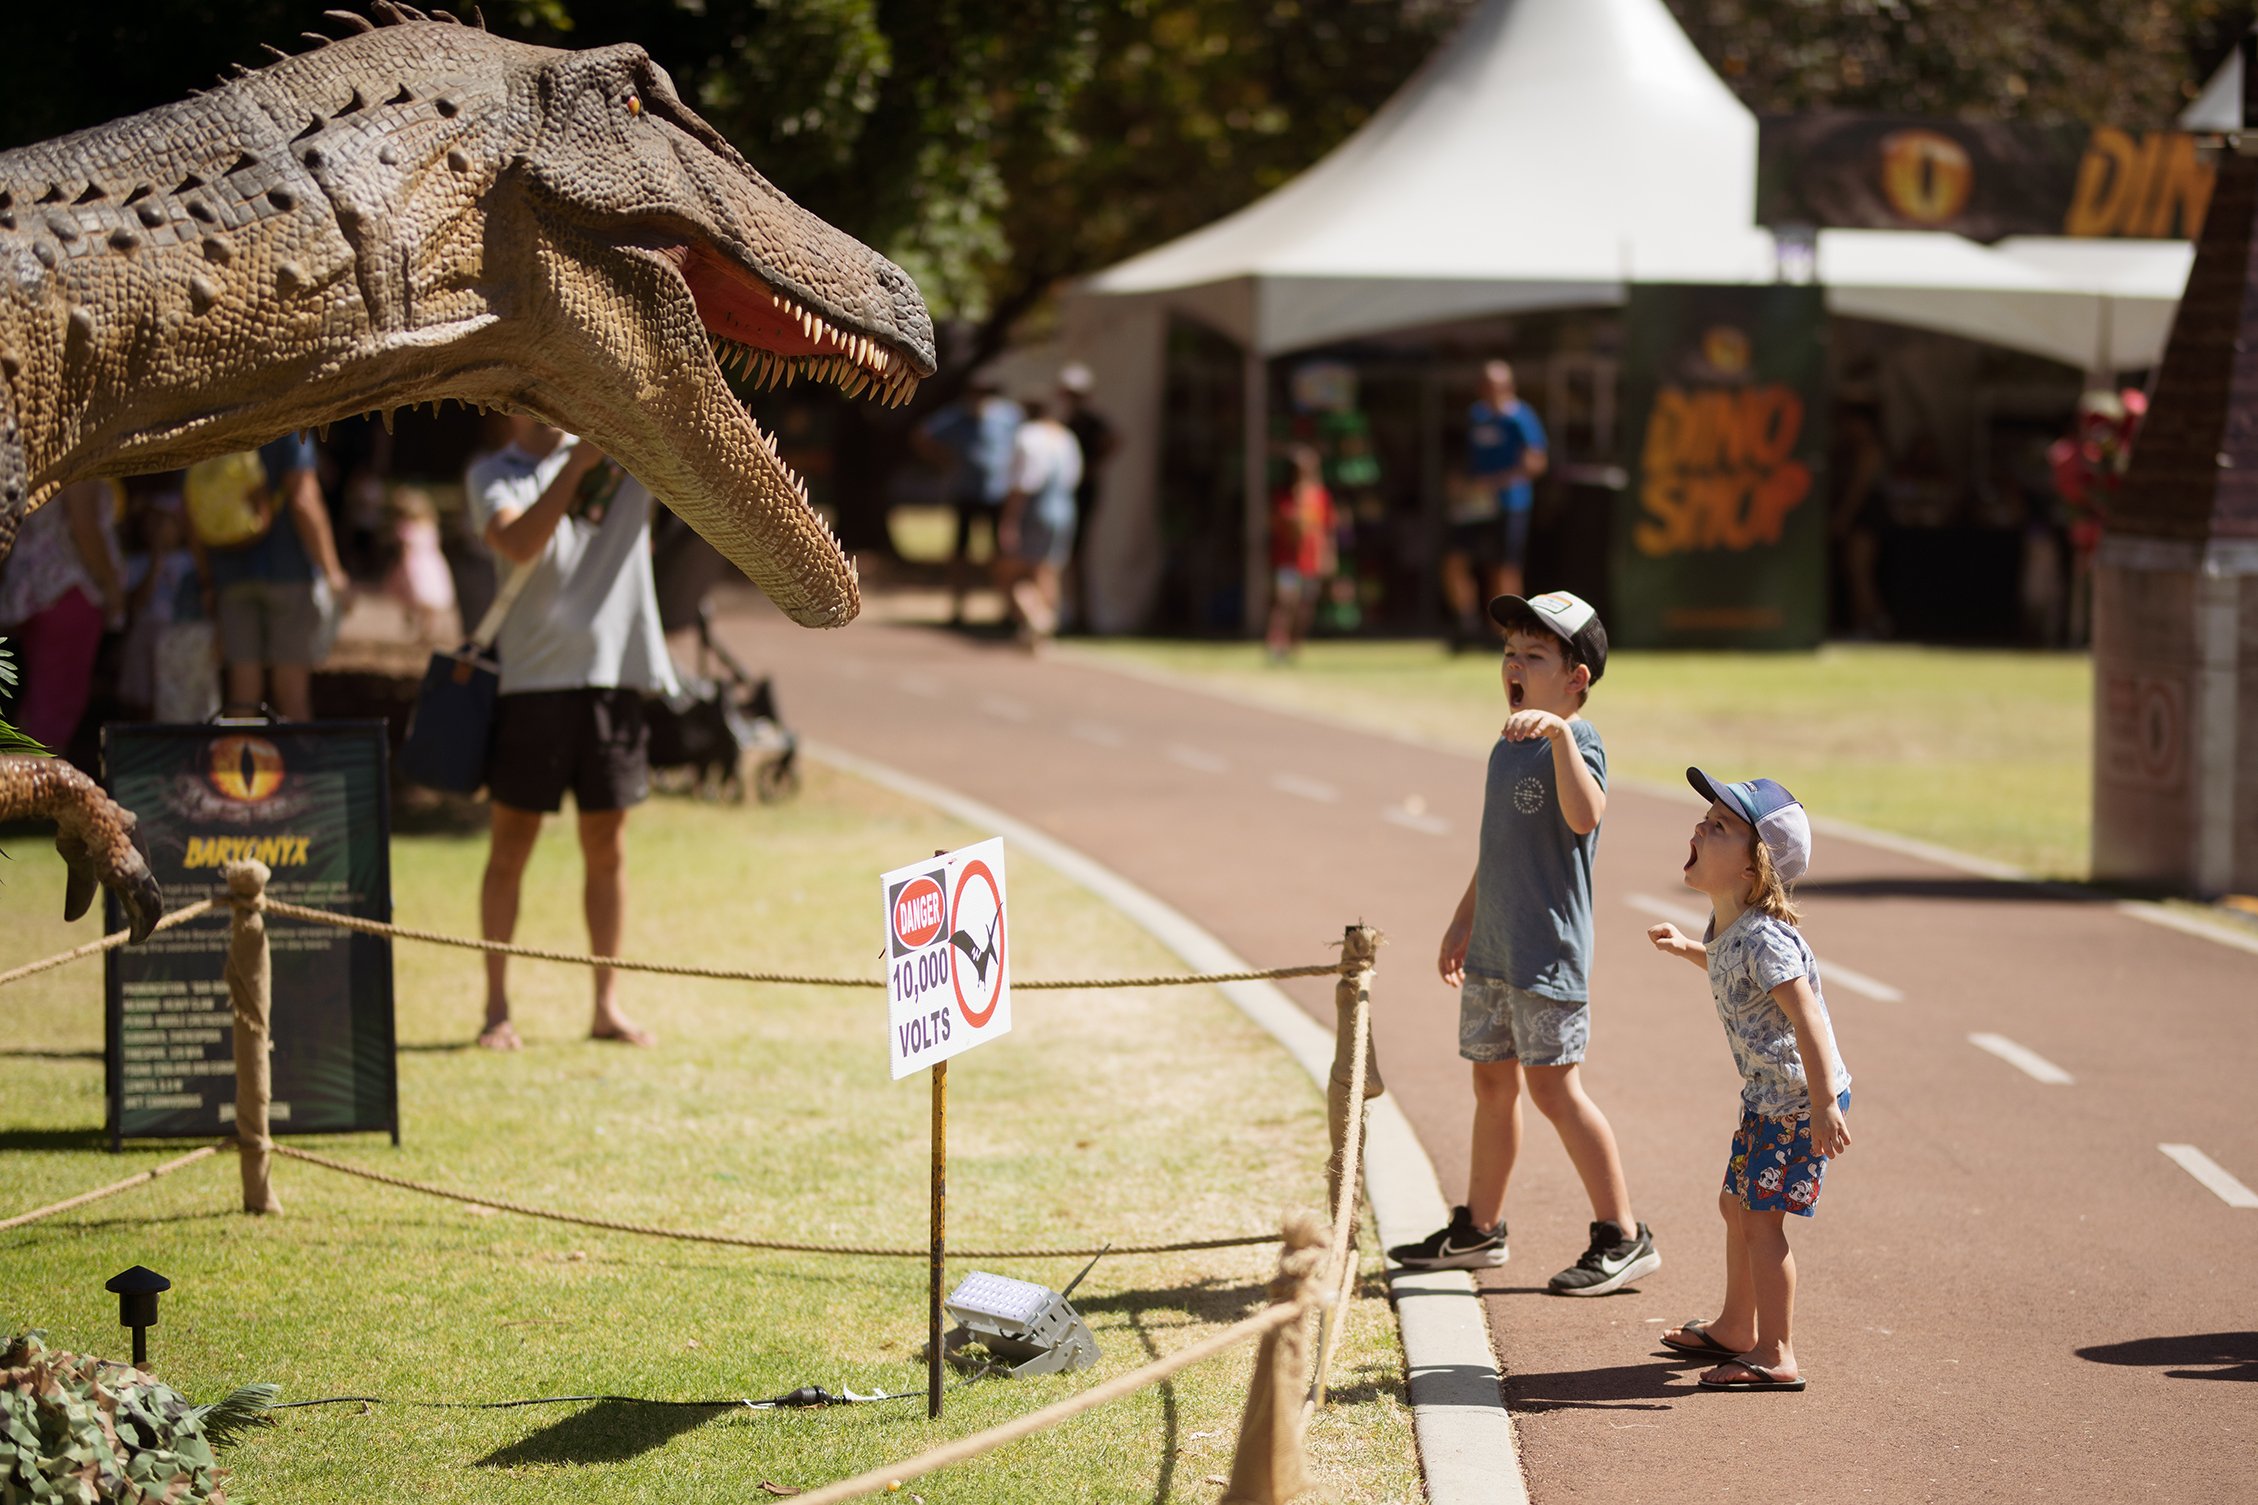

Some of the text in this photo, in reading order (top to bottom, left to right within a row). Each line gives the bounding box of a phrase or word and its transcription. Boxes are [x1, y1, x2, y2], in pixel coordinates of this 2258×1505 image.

[1646, 384, 1802, 467] DINO
[183, 836, 310, 868] BARYONYX
[899, 891, 941, 935] DANGER
[893, 947, 948, 1003] 10,000
[899, 1006, 950, 1058] VOLTS
